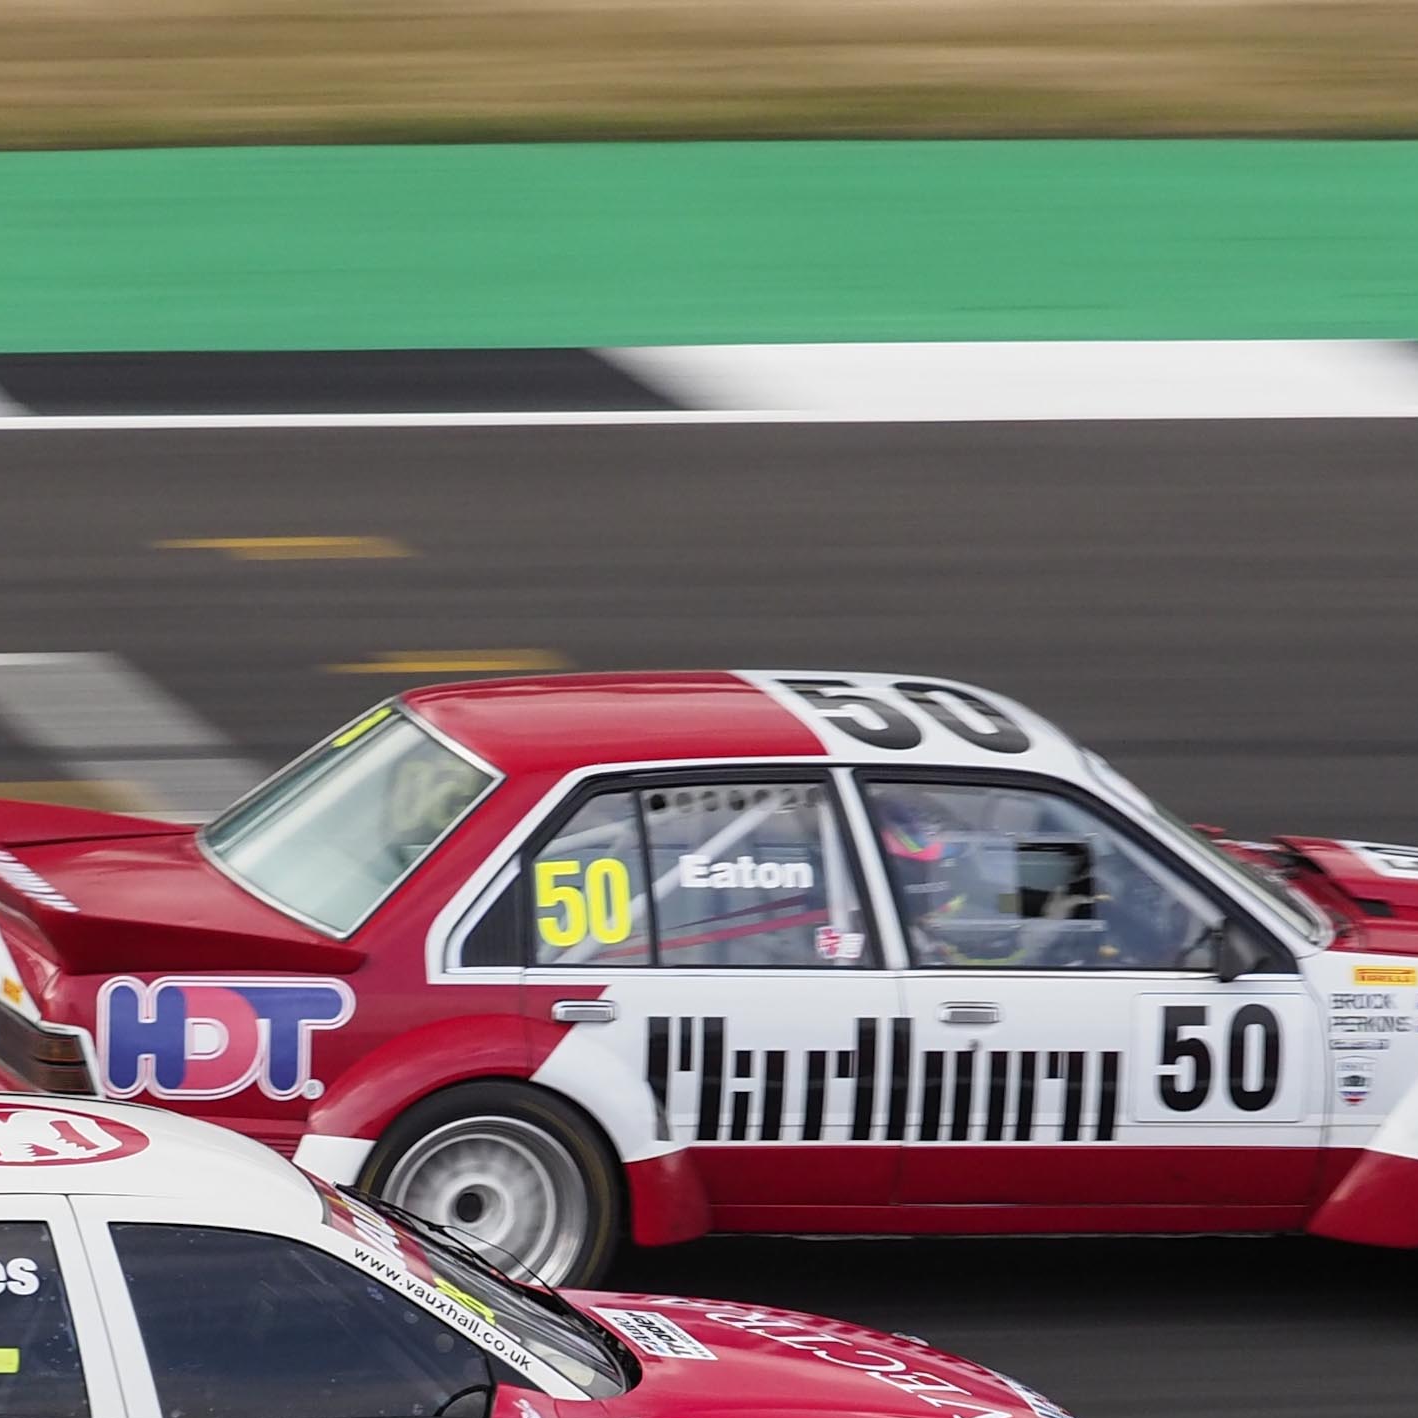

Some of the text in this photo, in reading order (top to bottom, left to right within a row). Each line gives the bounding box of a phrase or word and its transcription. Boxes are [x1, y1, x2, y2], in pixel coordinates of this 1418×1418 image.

[773, 678, 1032, 754] 50
[535, 858, 633, 946] 50
[680, 855, 814, 889] Eaton
[107, 984, 347, 1092] HDT
[1156, 1003, 1280, 1112] 50
[353, 1247, 533, 1371] www.vauxhall.co.uk
